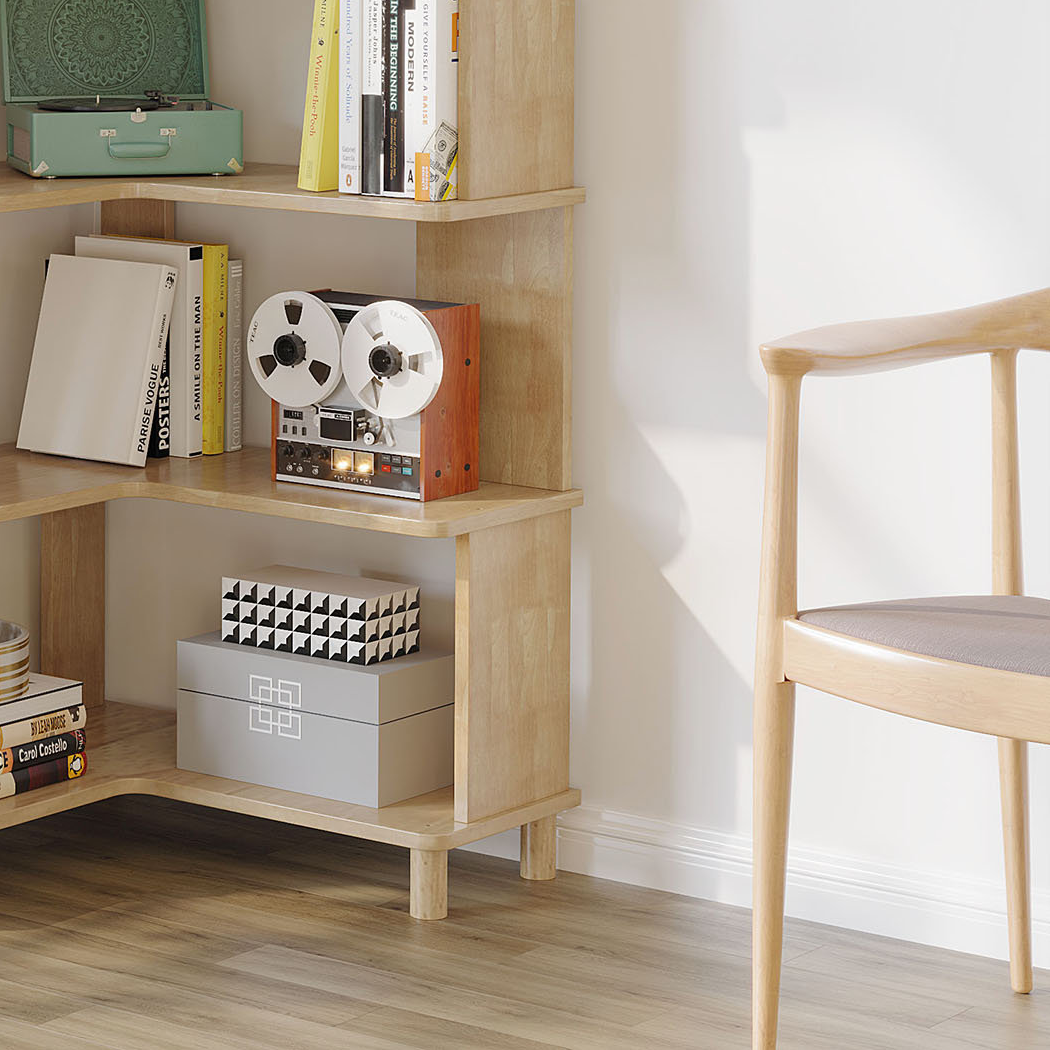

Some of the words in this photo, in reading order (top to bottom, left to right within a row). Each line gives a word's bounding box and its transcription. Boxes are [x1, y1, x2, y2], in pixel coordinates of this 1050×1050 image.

[319, 0, 327, 27] MILNE
[389, 0, 399, 14] IN
[389, 16, 399, 40] THE
[407, 22, 415, 92] MODERN
[389, 42, 399, 111] BEGINNING
[309, 54, 324, 137] Winnie-the-Pooh
[345, 83, 353, 124] Solitude
[250, 321, 259, 343] TEAC
[194, 353, 201, 371] ON
[137, 408, 152, 453] PARISE
[145, 364, 159, 406] VOGUE
[158, 376, 170, 450] POSTERS
[194, 413, 201, 421] A
[18, 745, 38, 762] Carol
[39, 738, 68, 757] Costello
